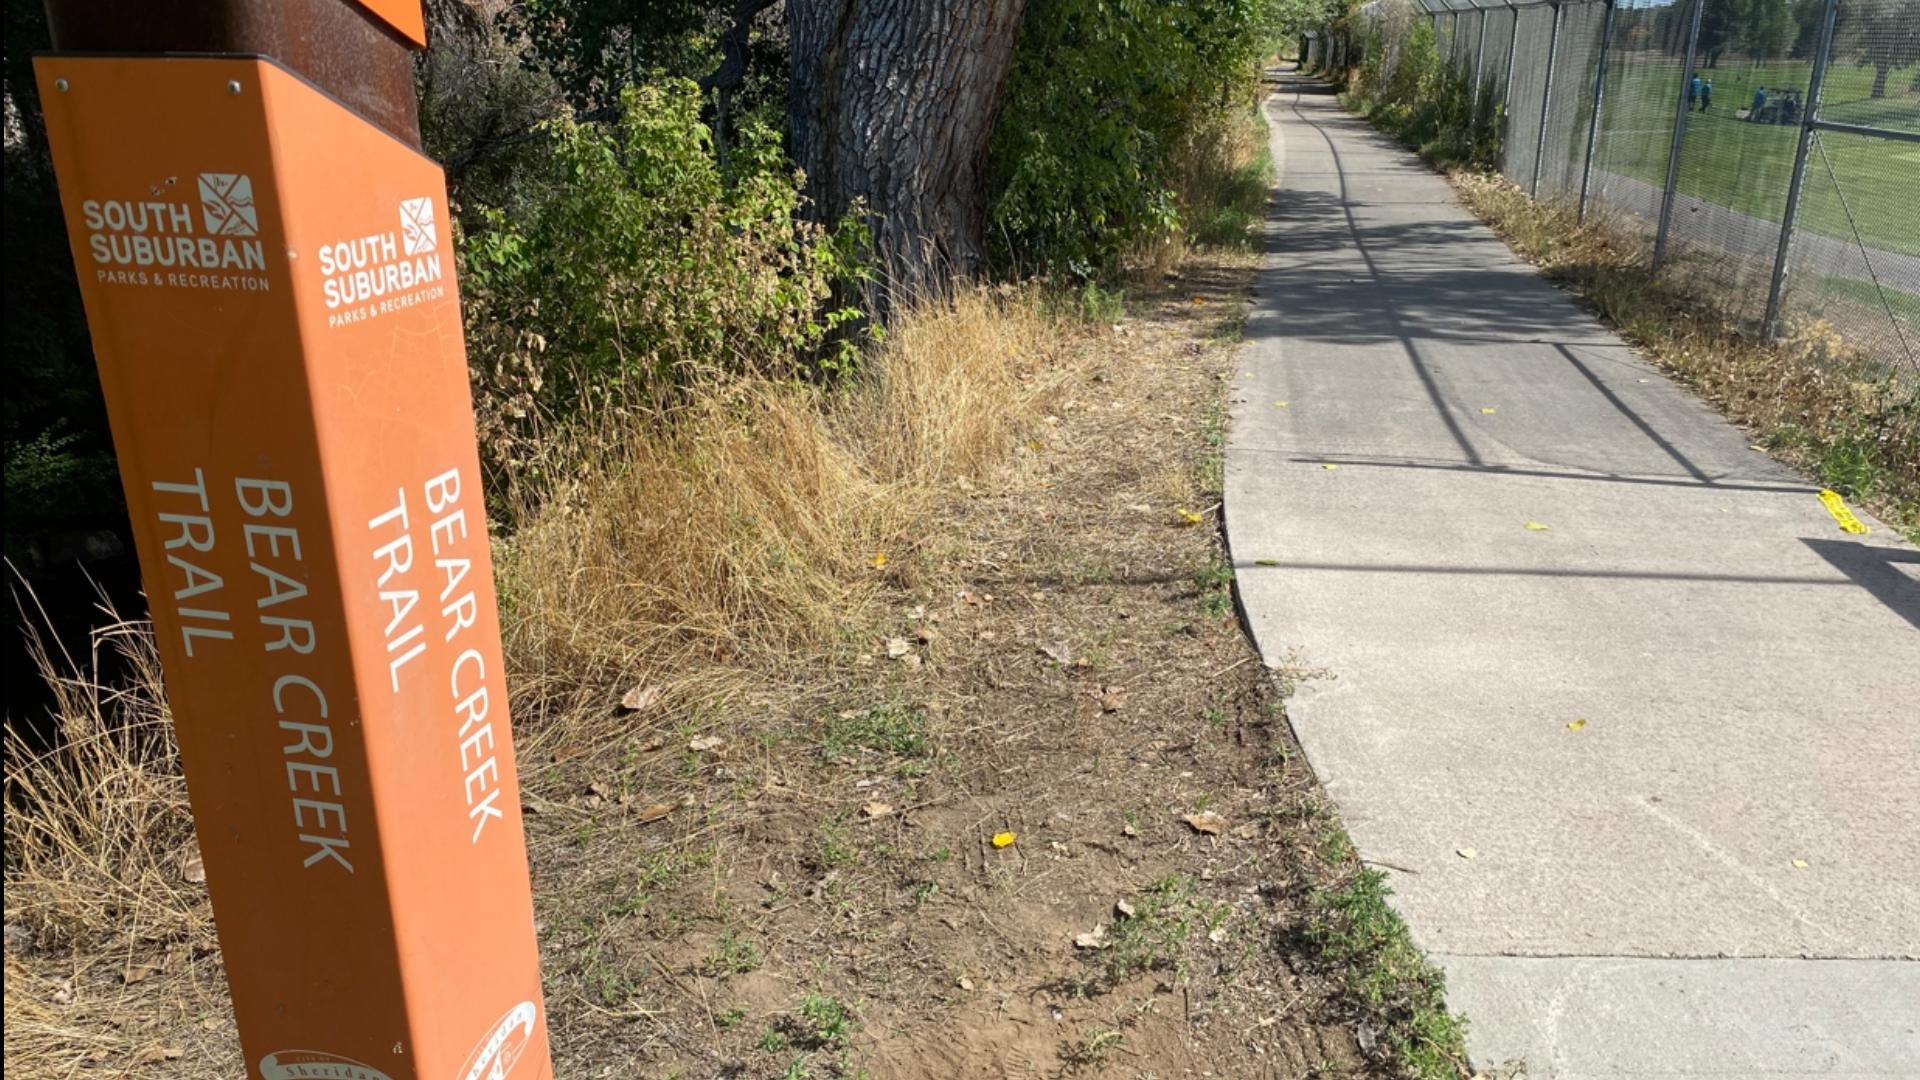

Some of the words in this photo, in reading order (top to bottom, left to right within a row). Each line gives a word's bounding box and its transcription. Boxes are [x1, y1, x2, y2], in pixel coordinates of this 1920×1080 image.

[83, 200, 193, 233] SOUTH
[90, 234, 266, 271] SUBURBAN
[97, 270, 148, 285] PARKS
[153, 273, 163, 286] &
[168, 274, 270, 291] RECREATION
[319, 232, 397, 276] SOUTH
[324, 254, 442, 309] SUBURBAN
[329, 307, 367, 328] PARKS
[370, 304, 377, 317] &
[381, 286, 444, 313] RECREATION
[152, 467, 235, 658] TRAIL
[235, 476, 317, 655] BEAR
[369, 487, 427, 694] TRAIL
[424, 467, 478, 643] BEAR
[451, 648, 503, 845] CREEK
[273, 674, 355, 875] CREEK
[471, 1010, 523, 1080] heridan
